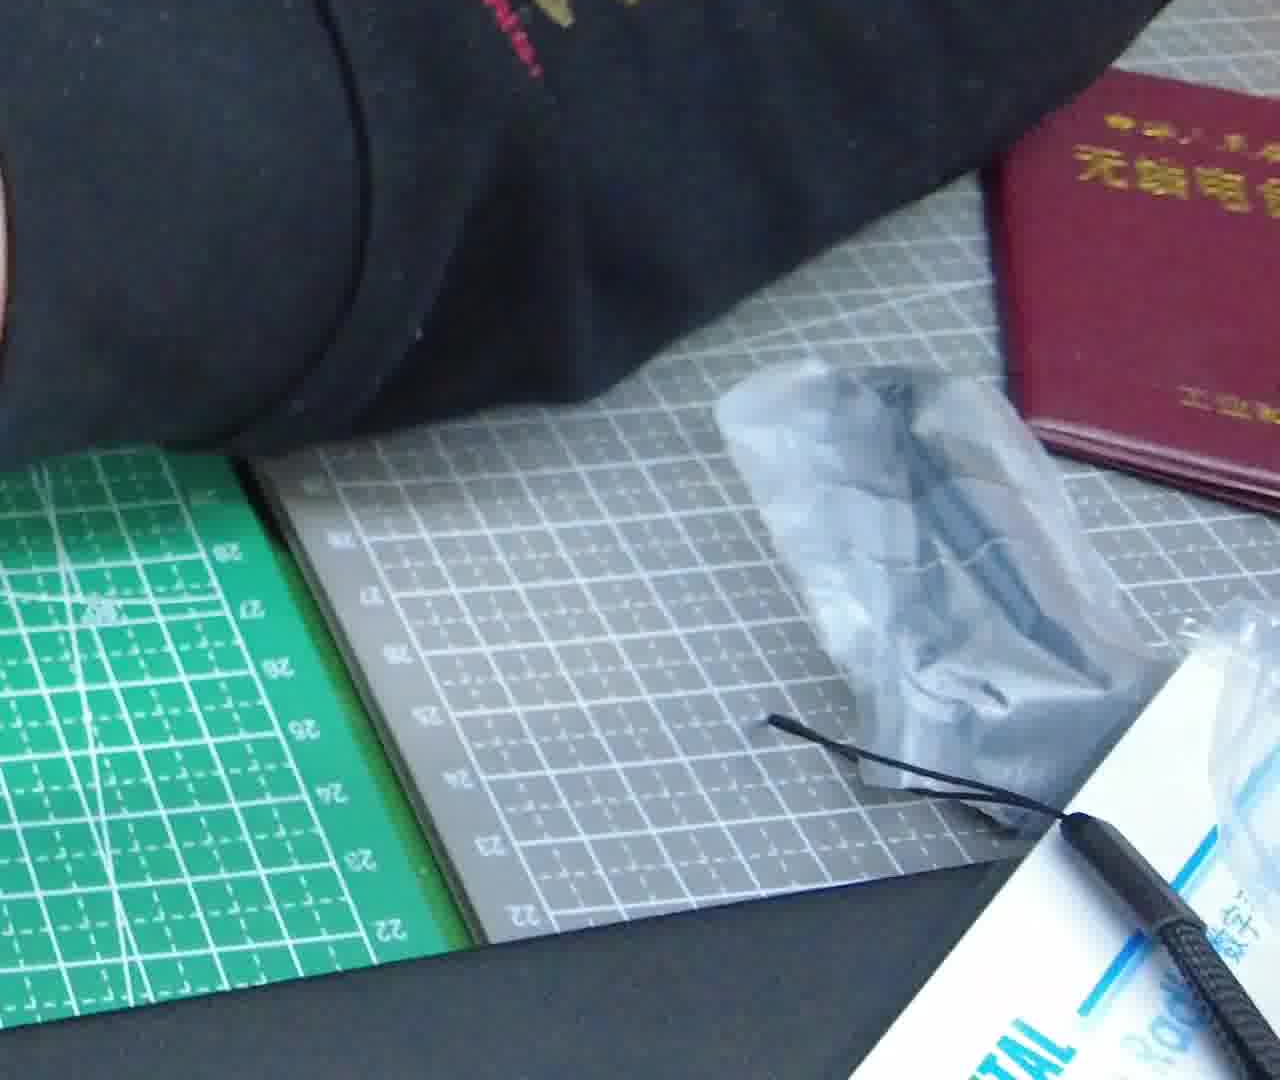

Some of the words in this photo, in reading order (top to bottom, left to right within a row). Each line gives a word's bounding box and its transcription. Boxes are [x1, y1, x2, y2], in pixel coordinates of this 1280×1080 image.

[506, 903, 542, 928] 22
[374, 918, 408, 942] 22
[967, 1018, 1078, 1080] TAL
